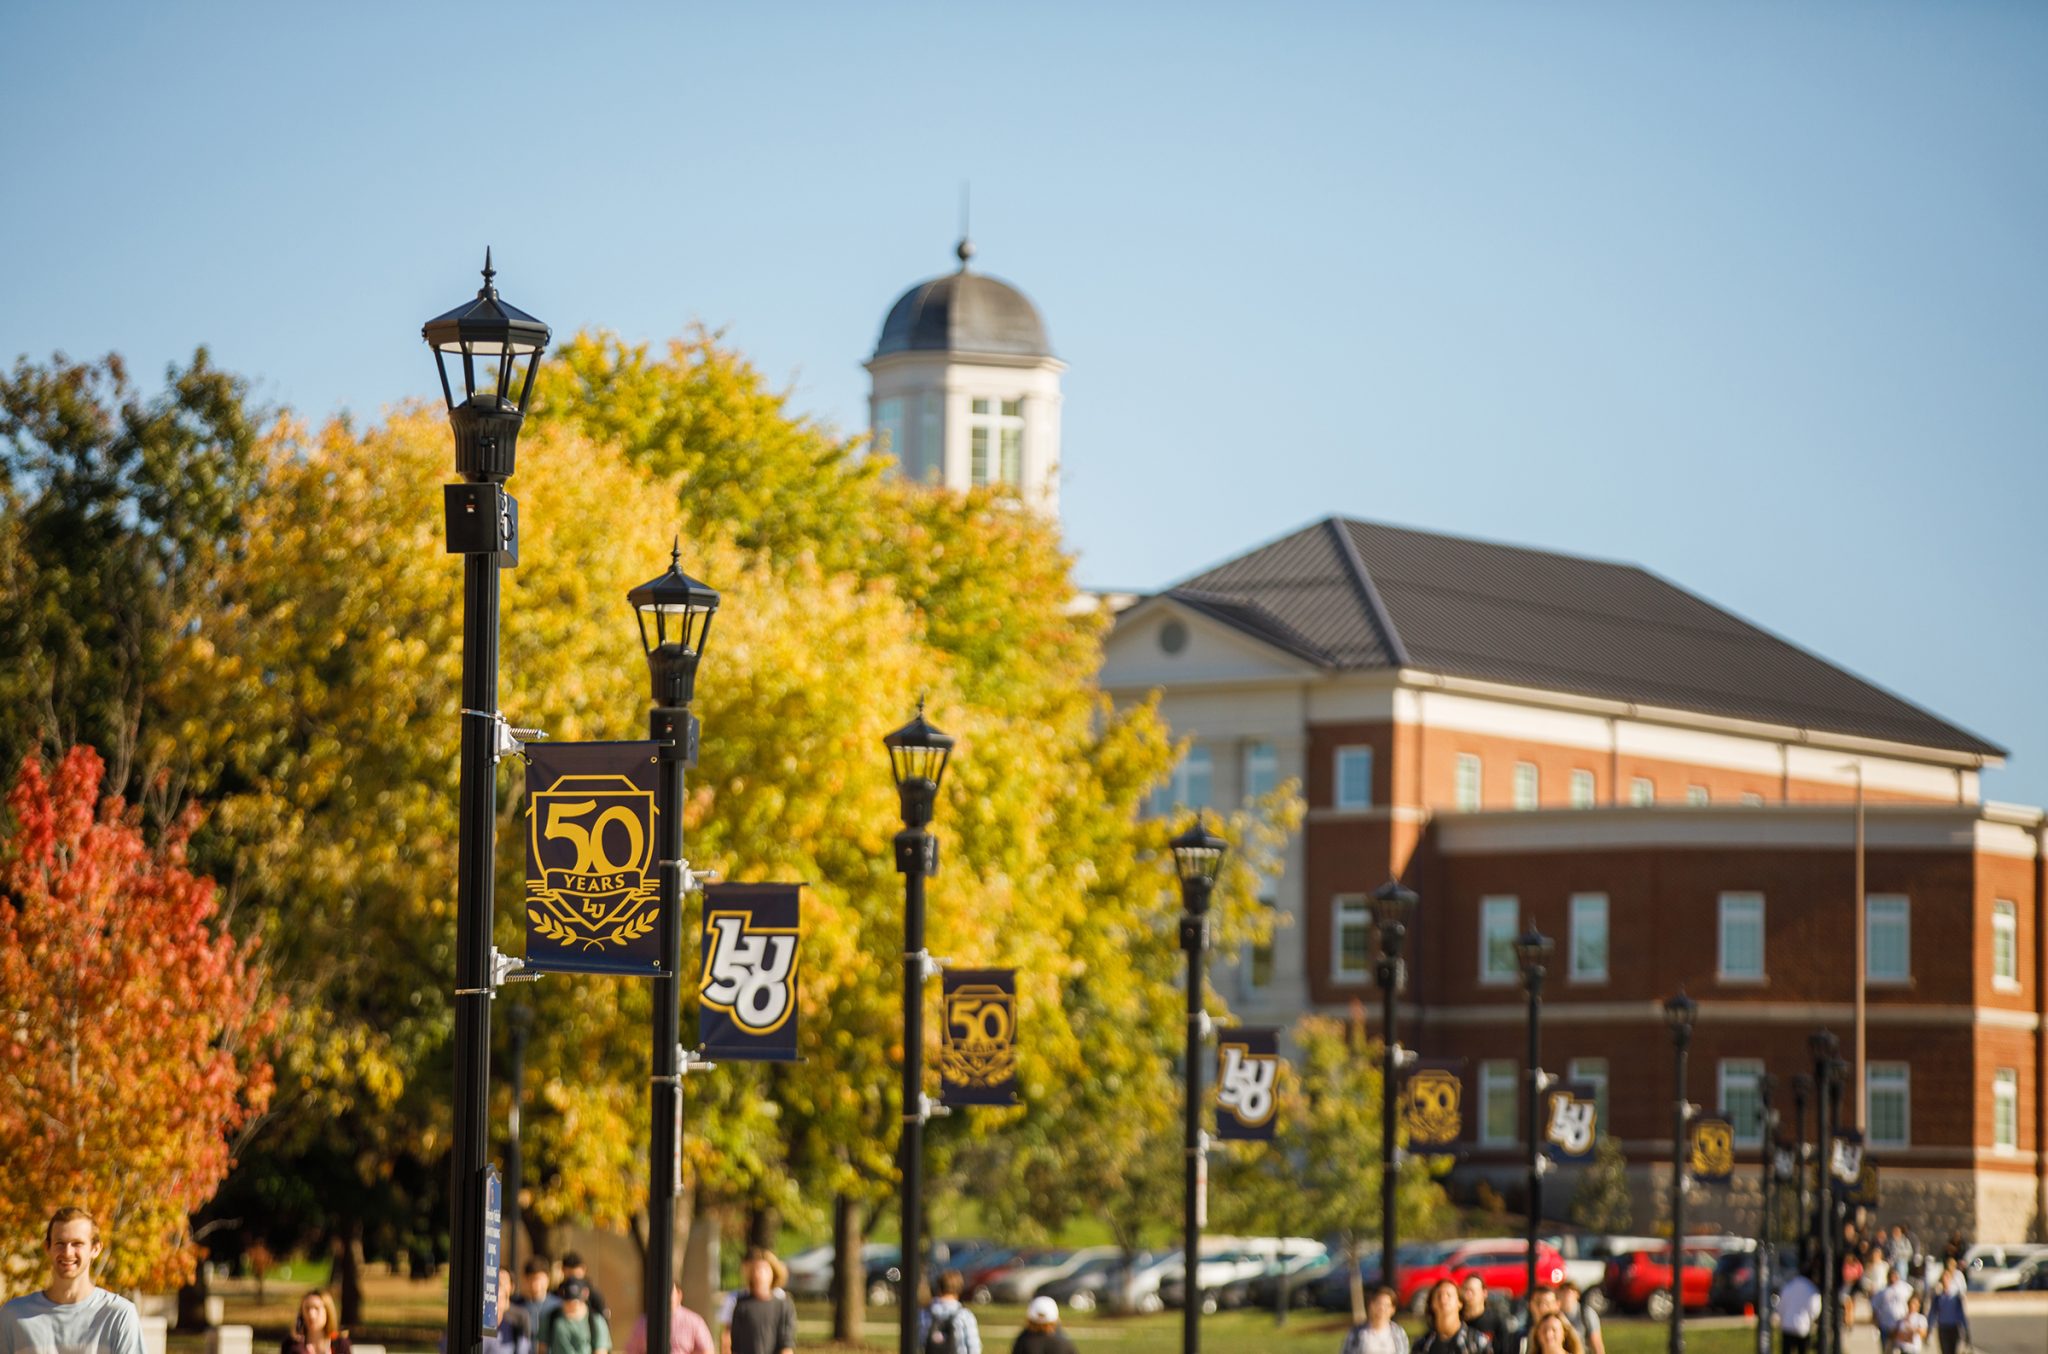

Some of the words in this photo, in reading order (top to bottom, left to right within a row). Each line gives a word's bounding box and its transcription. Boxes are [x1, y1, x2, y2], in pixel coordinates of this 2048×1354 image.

[544, 800, 644, 873] 50
[564, 874, 625, 891] YEARS
[582, 898, 606, 918] LU
[703, 966, 787, 1026] 50
[950, 1000, 1010, 1042] 50
